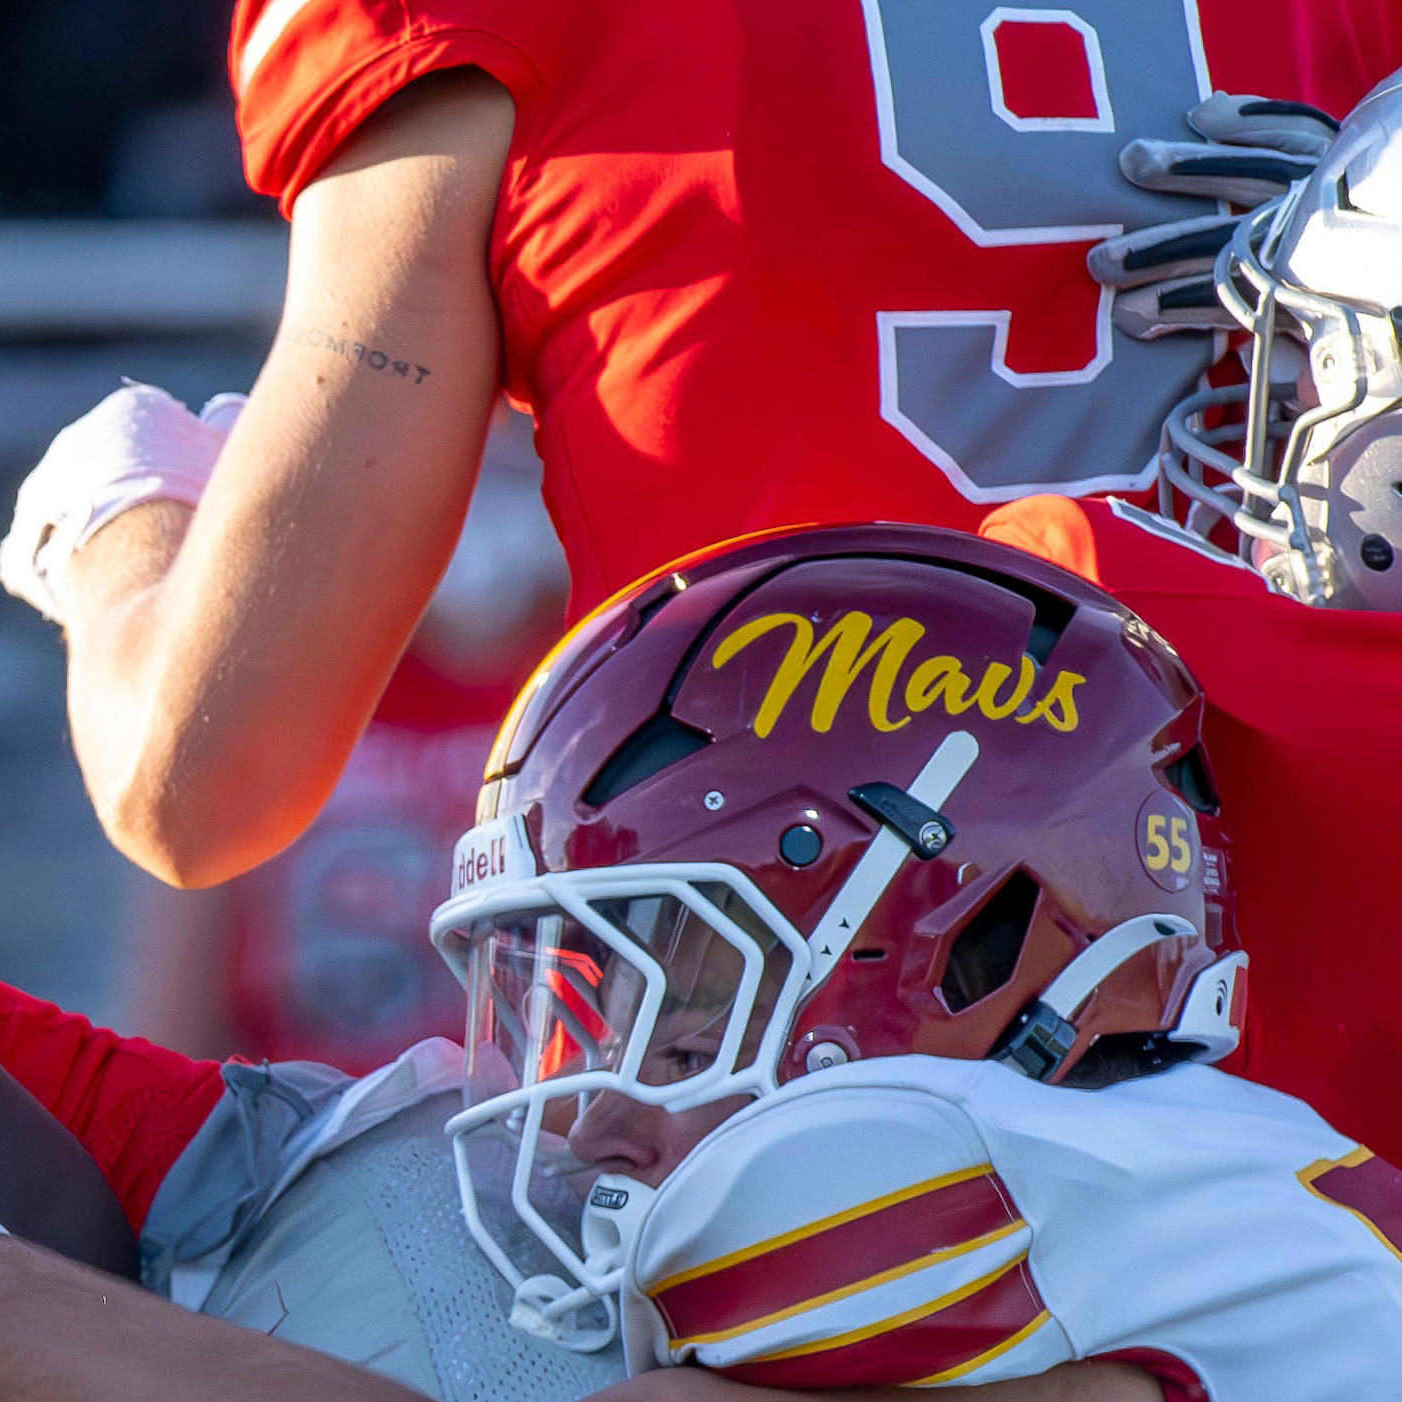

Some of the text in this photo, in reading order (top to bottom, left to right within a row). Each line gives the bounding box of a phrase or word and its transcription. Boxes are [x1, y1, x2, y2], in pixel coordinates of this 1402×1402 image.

[860, 0, 1225, 505] 9
[712, 610, 1087, 739] Mavs
[1146, 813, 1192, 874] 55
